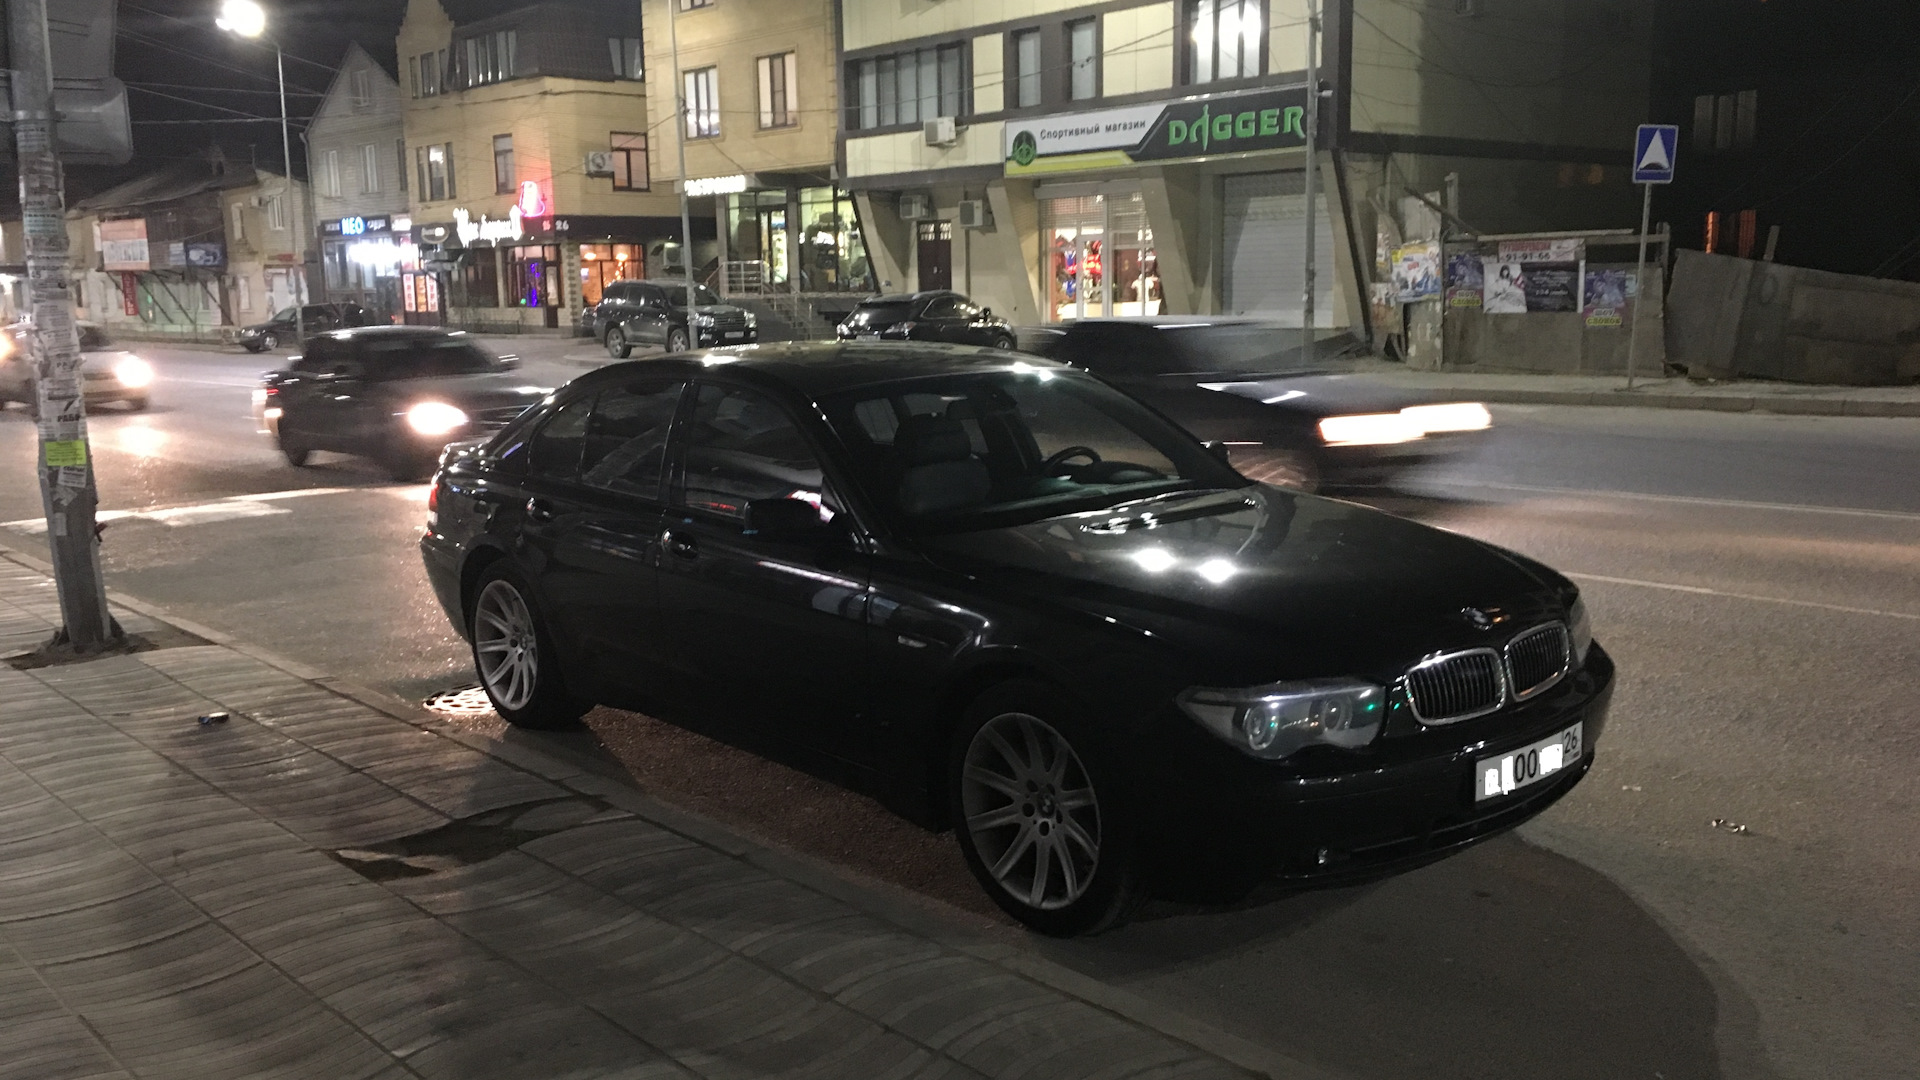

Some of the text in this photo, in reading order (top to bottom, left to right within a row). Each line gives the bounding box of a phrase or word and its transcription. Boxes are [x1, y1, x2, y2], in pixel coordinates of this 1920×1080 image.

[1040, 120, 1146, 140] Спортивный магазин
[1168, 104, 1307, 151] DAGGER
[555, 219, 569, 231] 26
[1564, 728, 1578, 754] 26
